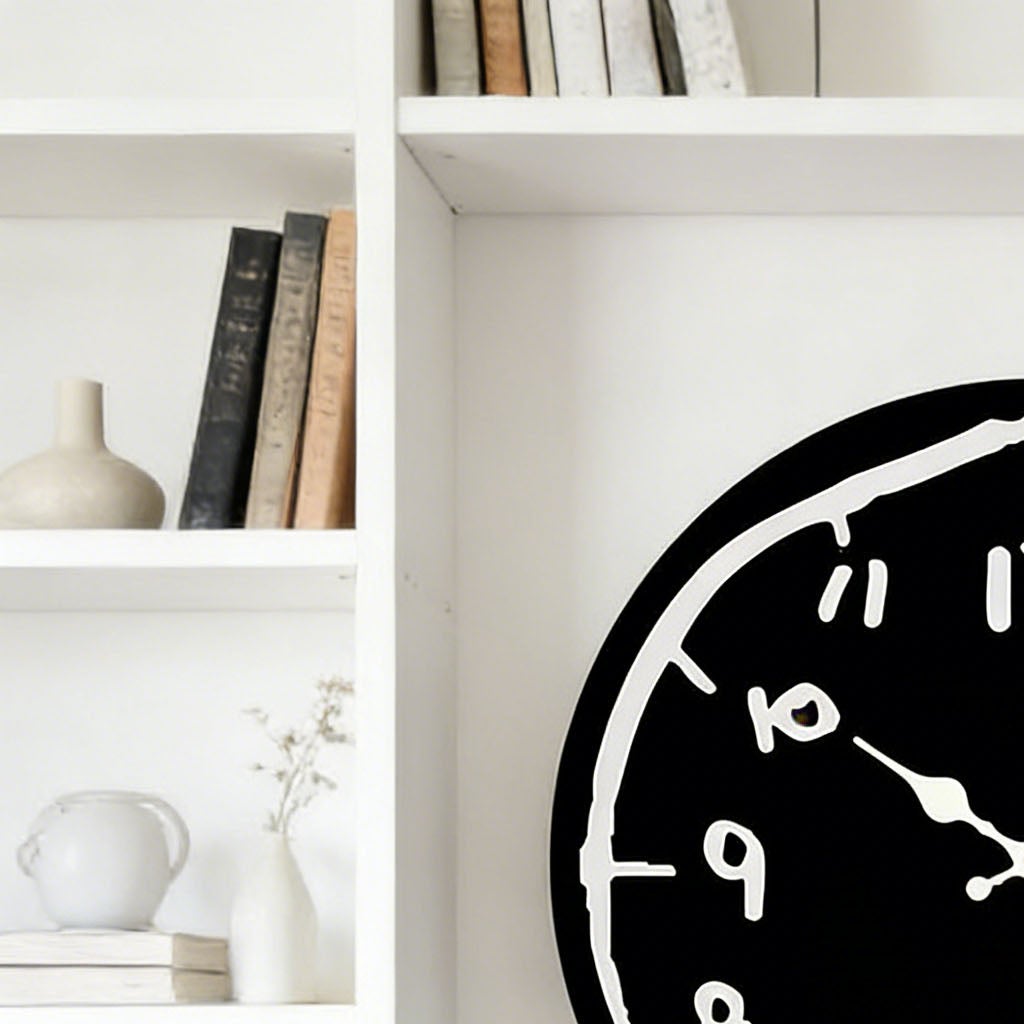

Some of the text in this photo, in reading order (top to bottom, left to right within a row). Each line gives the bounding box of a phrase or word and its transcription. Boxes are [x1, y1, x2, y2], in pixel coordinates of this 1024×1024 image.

[818, 559, 888, 632] 11
[748, 683, 841, 754] 10
[704, 820, 766, 922] 9
